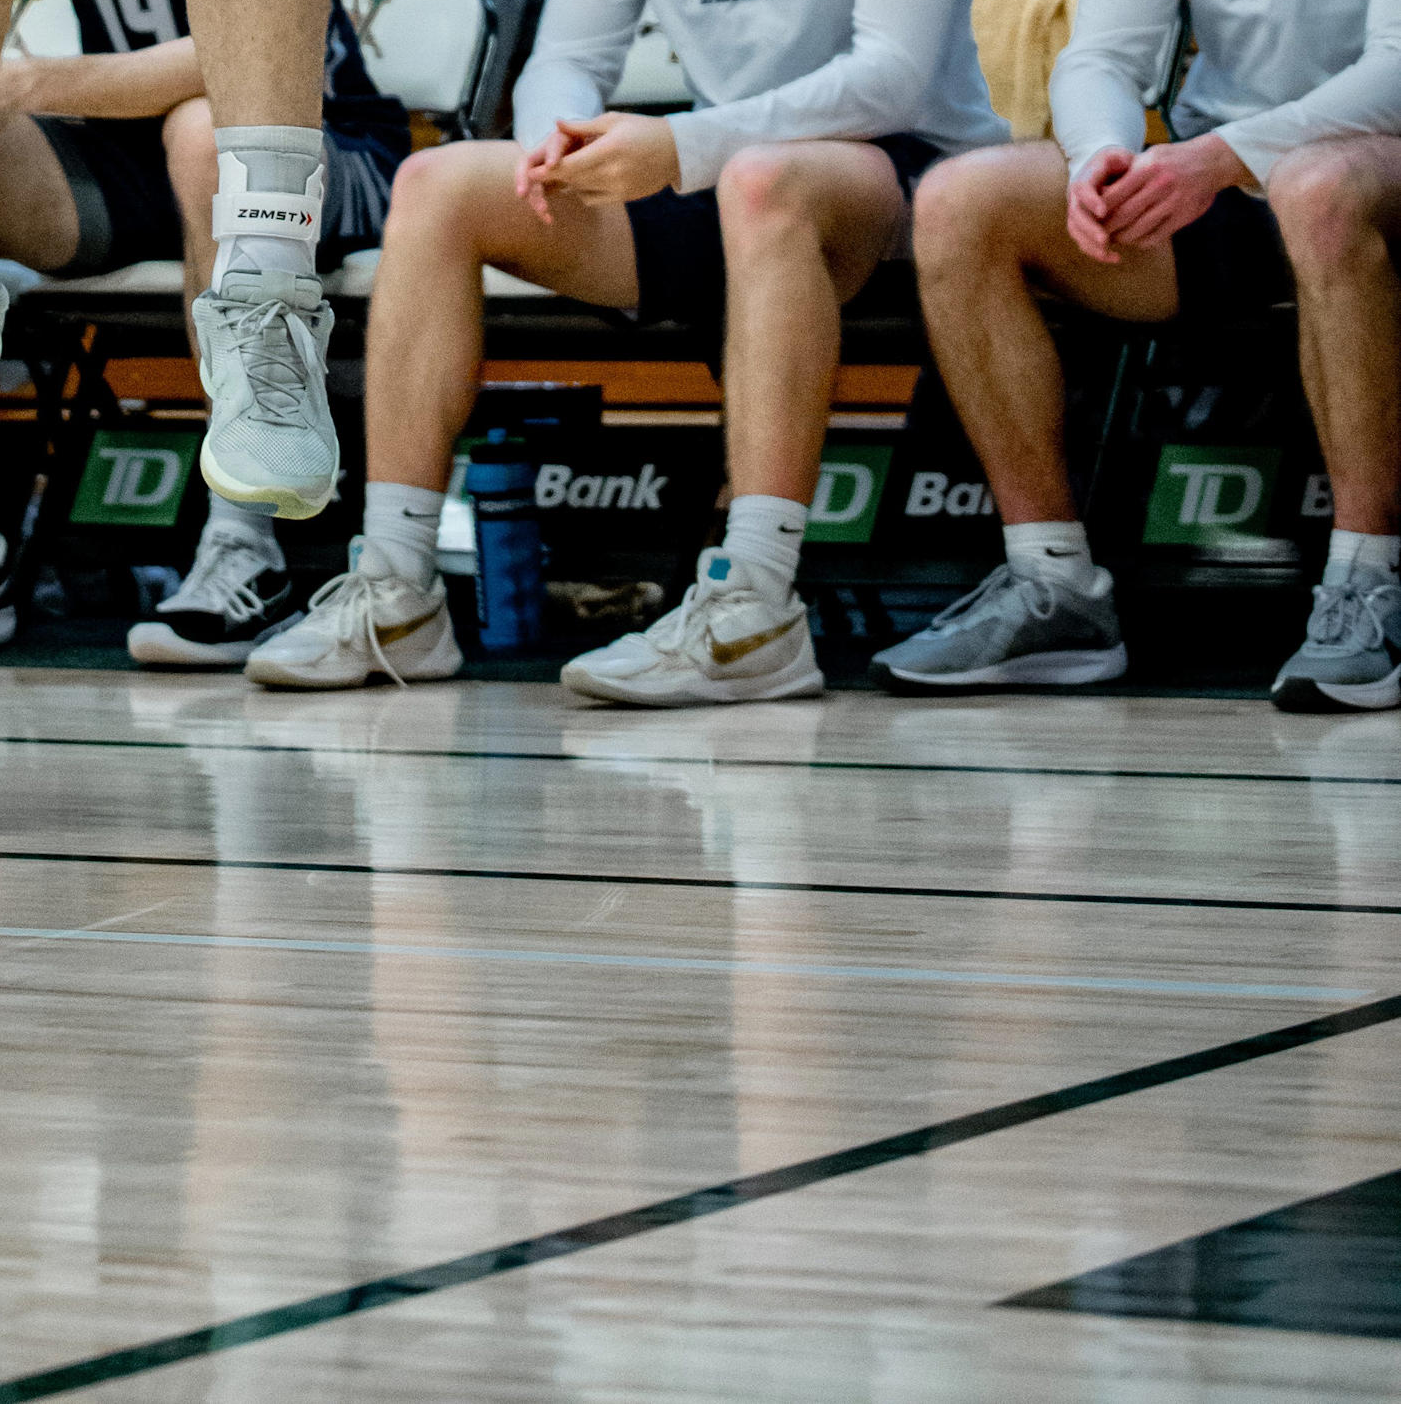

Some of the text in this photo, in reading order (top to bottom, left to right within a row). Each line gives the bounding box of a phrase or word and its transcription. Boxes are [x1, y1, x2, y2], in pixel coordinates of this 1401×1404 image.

[99, 448, 181, 506] TD
[535, 463, 669, 510] Bank
[1169, 464, 1263, 525] TD
